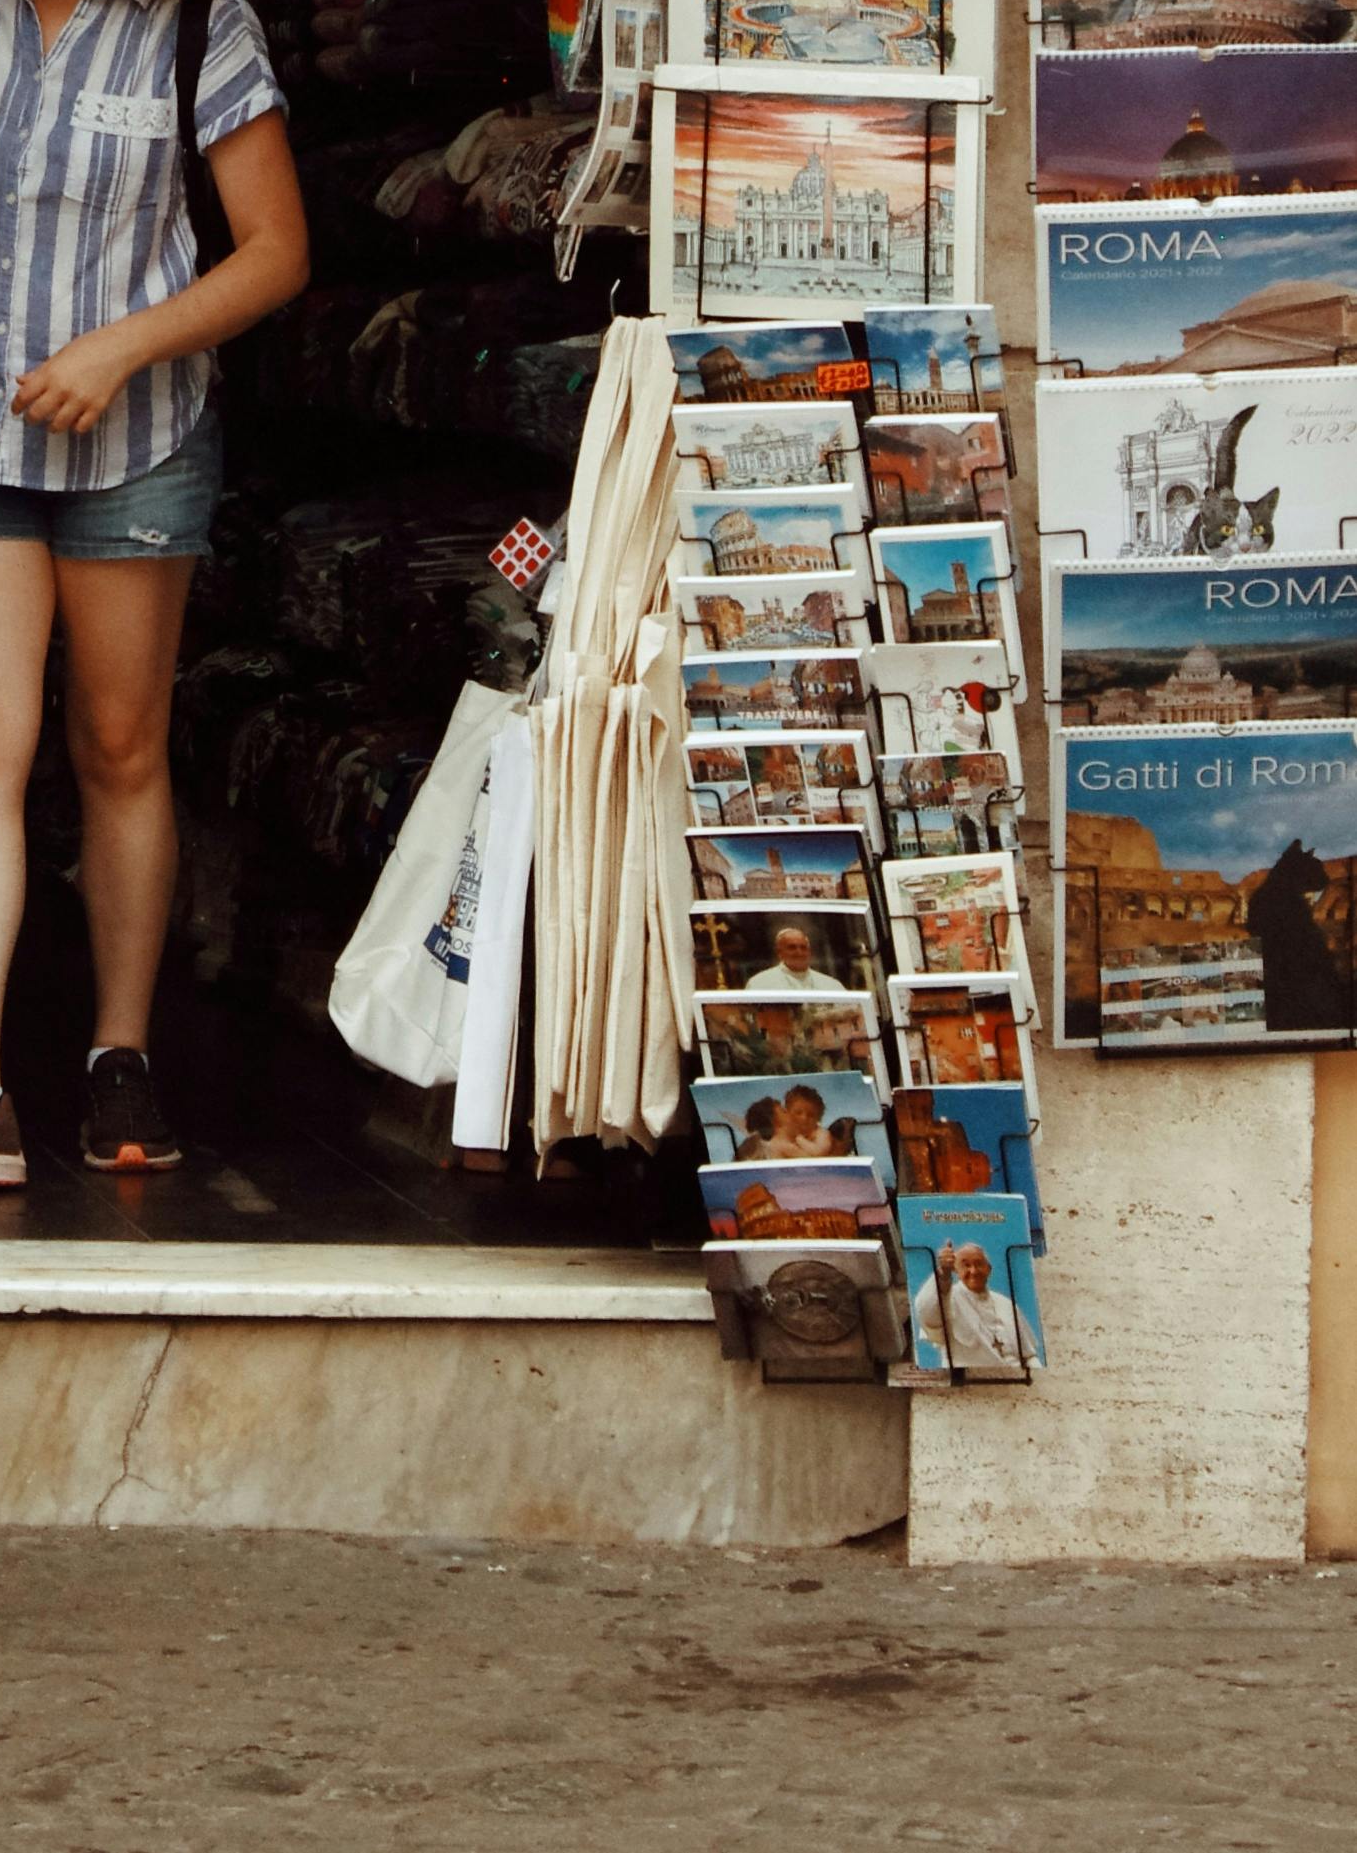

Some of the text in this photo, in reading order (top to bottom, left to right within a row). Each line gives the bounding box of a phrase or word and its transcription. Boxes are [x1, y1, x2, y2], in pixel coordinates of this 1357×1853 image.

[1059, 229, 1223, 265] ROMA
[1060, 265, 1224, 281] Calendario 2021 2022
[1286, 419, 1357, 446] 2022
[1205, 575, 1357, 610] ROMA
[1331, 608, 1357, 620] 202
[737, 709, 821, 722] TRASTEVERE
[1078, 760, 1179, 791] Gatti
[1196, 757, 1234, 788] di
